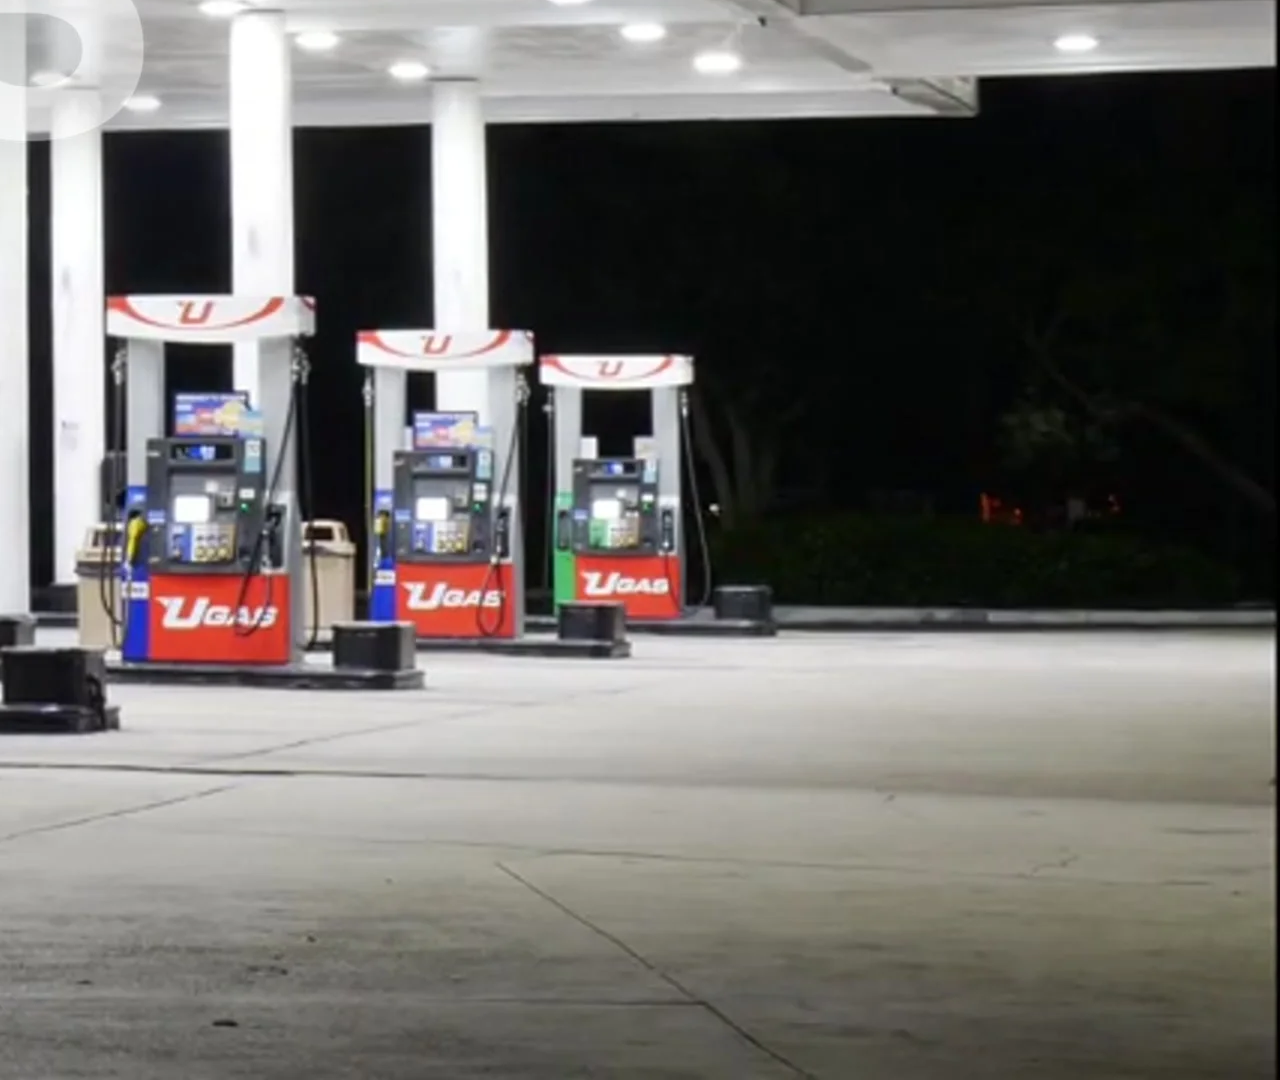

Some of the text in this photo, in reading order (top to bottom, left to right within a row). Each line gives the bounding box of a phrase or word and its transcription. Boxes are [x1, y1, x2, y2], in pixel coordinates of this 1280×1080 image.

[178, 301, 214, 324] U
[419, 335, 452, 355] U
[596, 360, 624, 377] U
[580, 571, 669, 595] UGAS
[400, 581, 507, 610] UGAS
